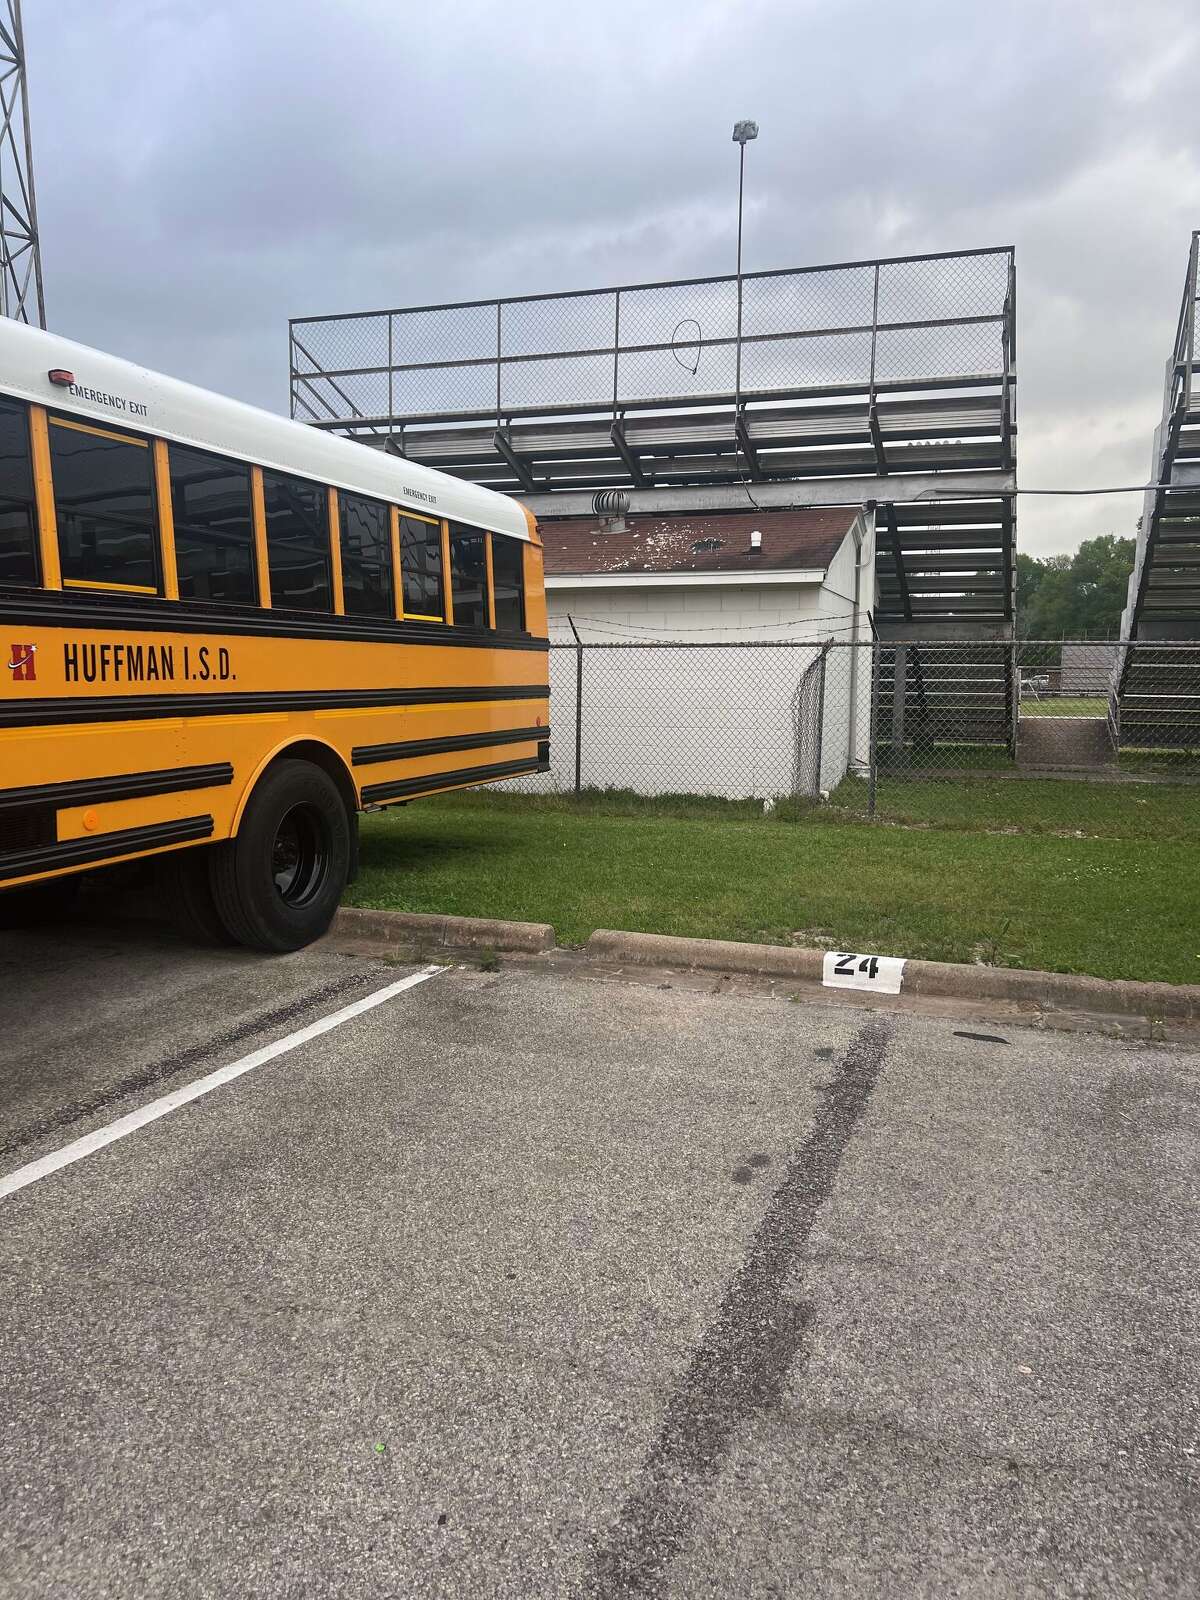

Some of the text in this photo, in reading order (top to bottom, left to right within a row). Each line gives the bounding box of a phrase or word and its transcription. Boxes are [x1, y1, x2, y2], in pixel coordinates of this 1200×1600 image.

[68, 383, 148, 416] EMERGENCY EXIT
[402, 486, 428, 501] EMERGENCY
[64, 643, 236, 682] HUFFMAN I.S.D.
[834, 953, 879, 979] 24
